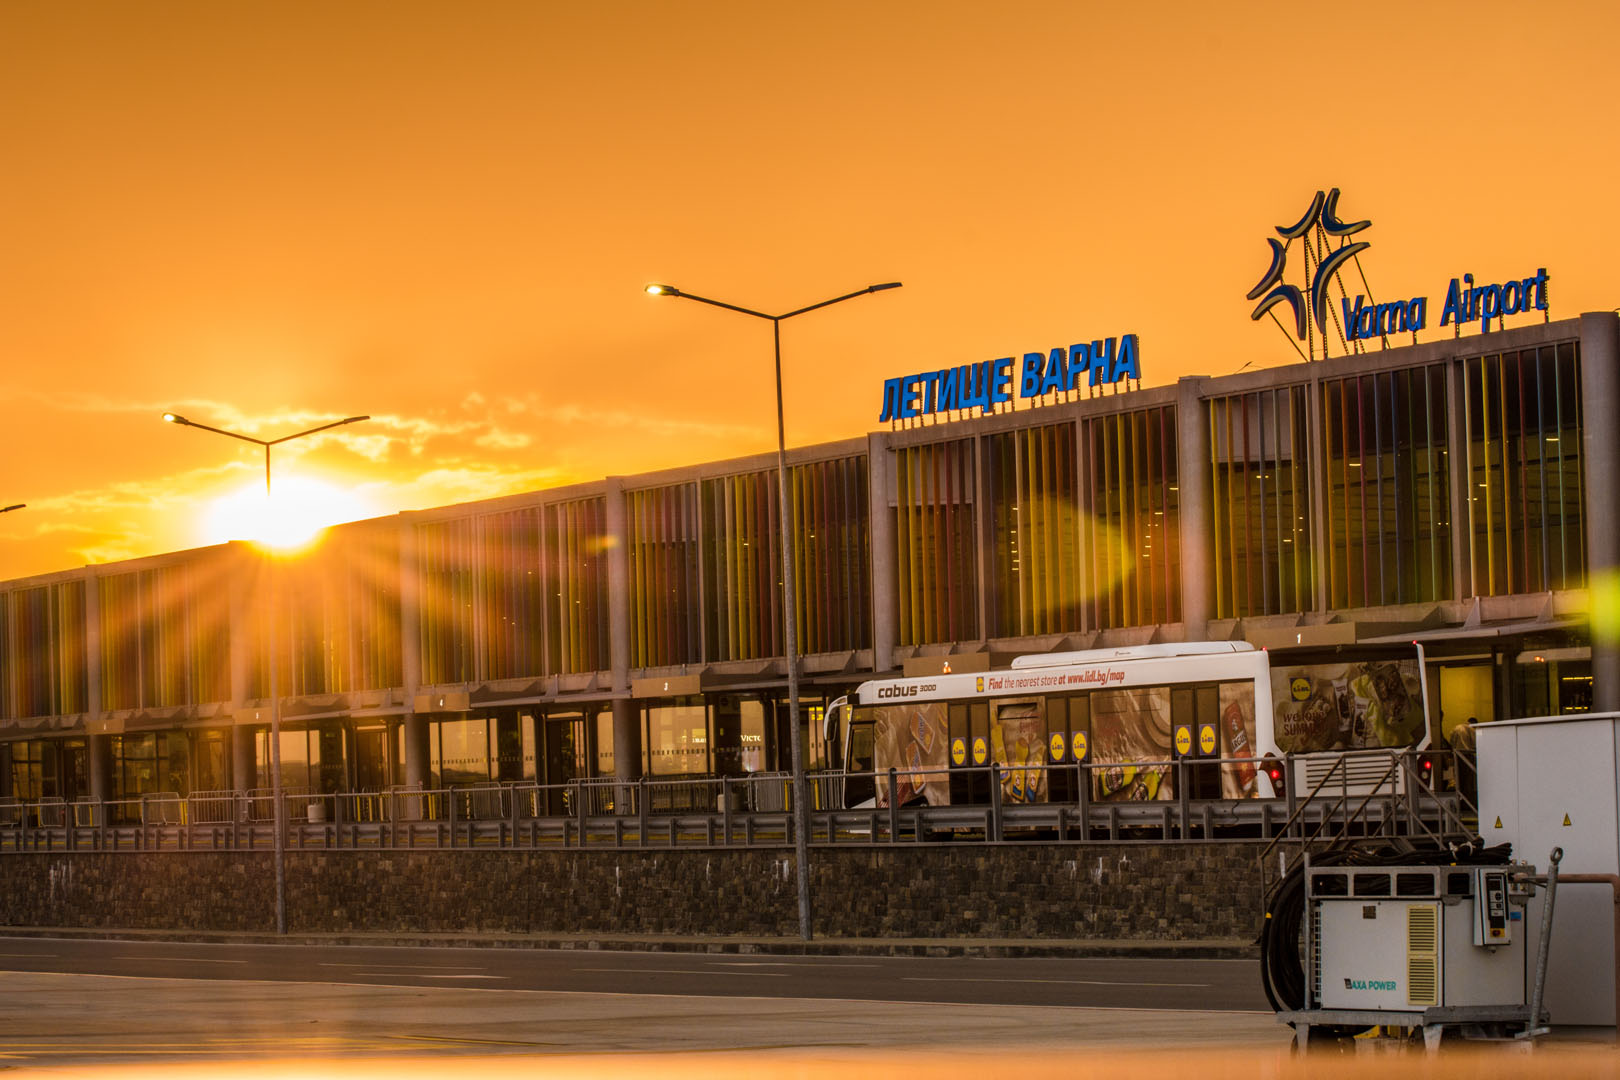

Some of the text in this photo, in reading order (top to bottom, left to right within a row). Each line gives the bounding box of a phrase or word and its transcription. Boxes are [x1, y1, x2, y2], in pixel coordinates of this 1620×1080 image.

[1341, 268, 1550, 341] Varna Airport
[879, 334, 1141, 423] ЛЕТИЩЕ ВАРНА
[989, 677, 1003, 690] Find
[1004, 677, 1015, 689] the
[1015, 676, 1040, 688] nearest
[1040, 675, 1057, 687] store
[1058, 673, 1066, 685] at
[1067, 667, 1125, 686] www.lidl.bg/map
[878, 684, 937, 698] cobus 3000
[1352, 980, 1397, 991] AXA POWER
